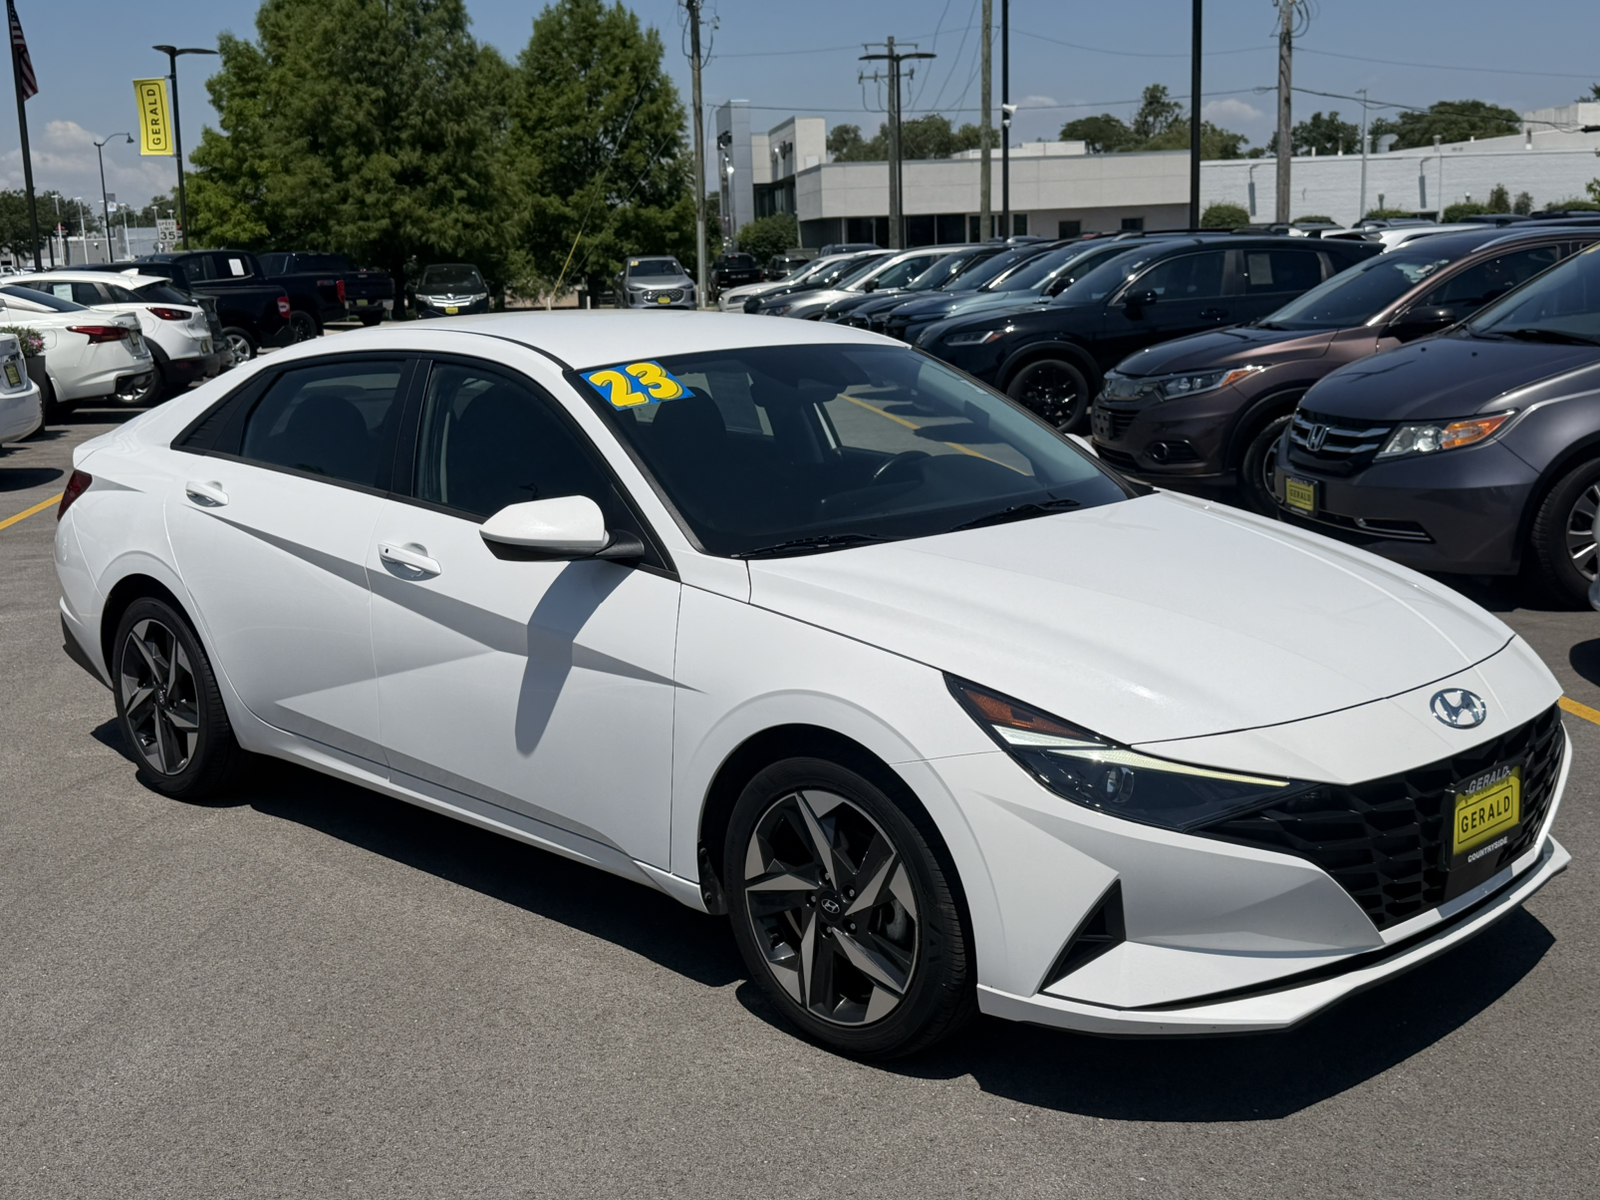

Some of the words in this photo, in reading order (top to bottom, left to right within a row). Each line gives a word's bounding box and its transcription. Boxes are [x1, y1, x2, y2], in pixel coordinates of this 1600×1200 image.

[146, 88, 161, 146] GERALD
[160, 231, 176, 240] 35
[588, 361, 684, 407] 23
[1289, 488, 1312, 502] GERALD
[1467, 765, 1510, 794] GERALD
[1461, 795, 1511, 834] GERALD
[1467, 836, 1508, 863] COUNTRYSIDE
